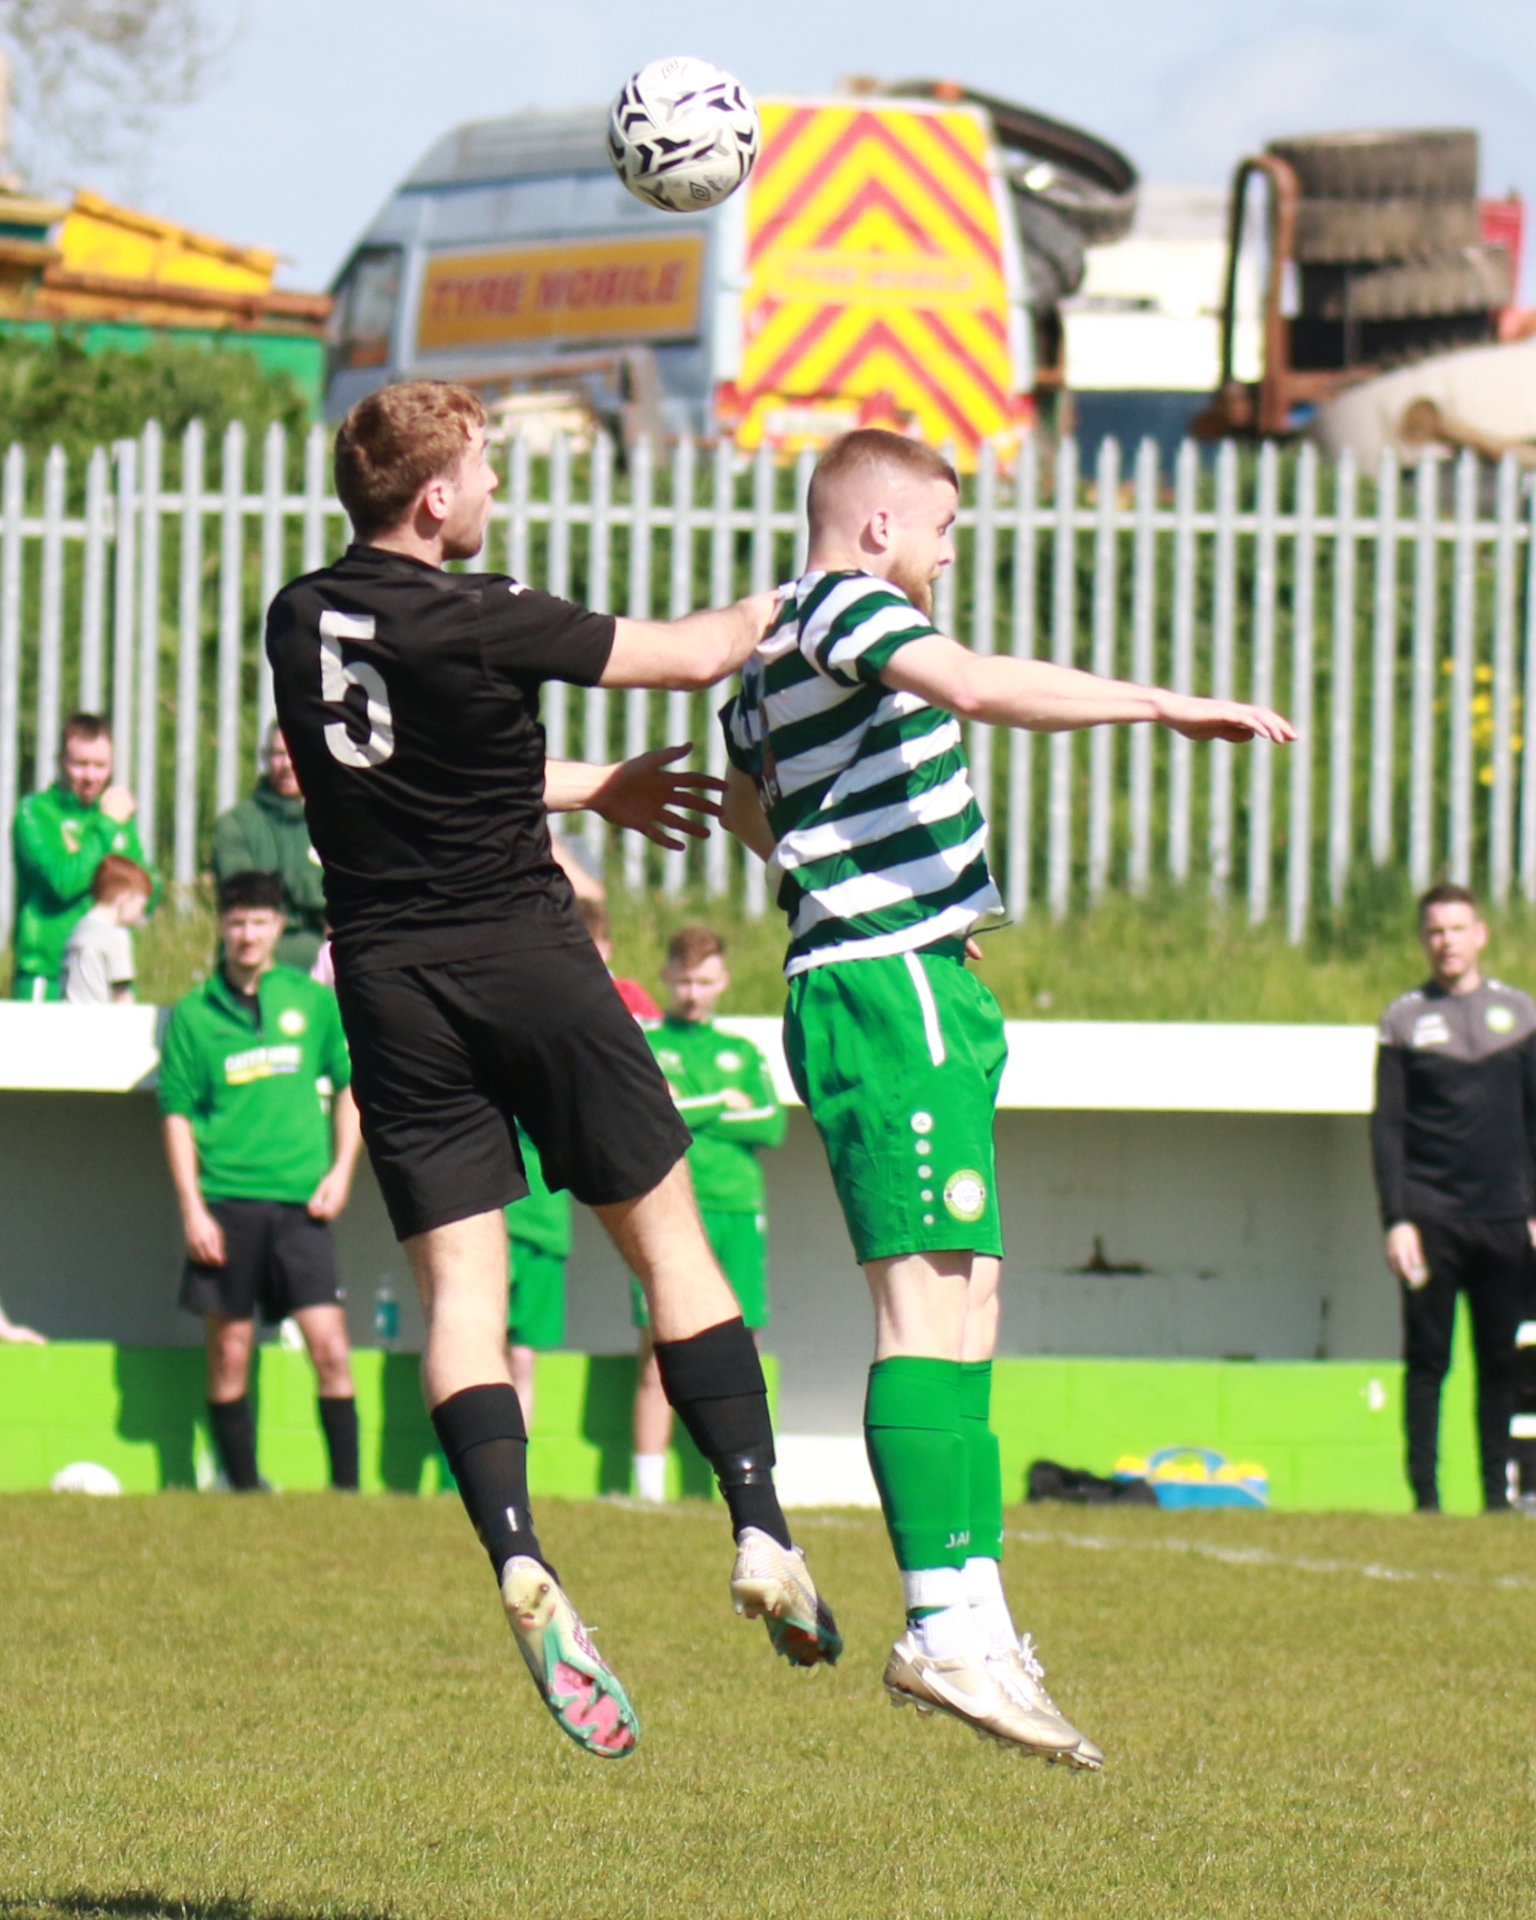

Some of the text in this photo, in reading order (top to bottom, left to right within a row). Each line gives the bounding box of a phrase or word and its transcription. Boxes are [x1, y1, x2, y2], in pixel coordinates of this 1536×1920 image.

[431, 259, 683, 319] TYRE MOBILE
[319, 610, 394, 768] 5
